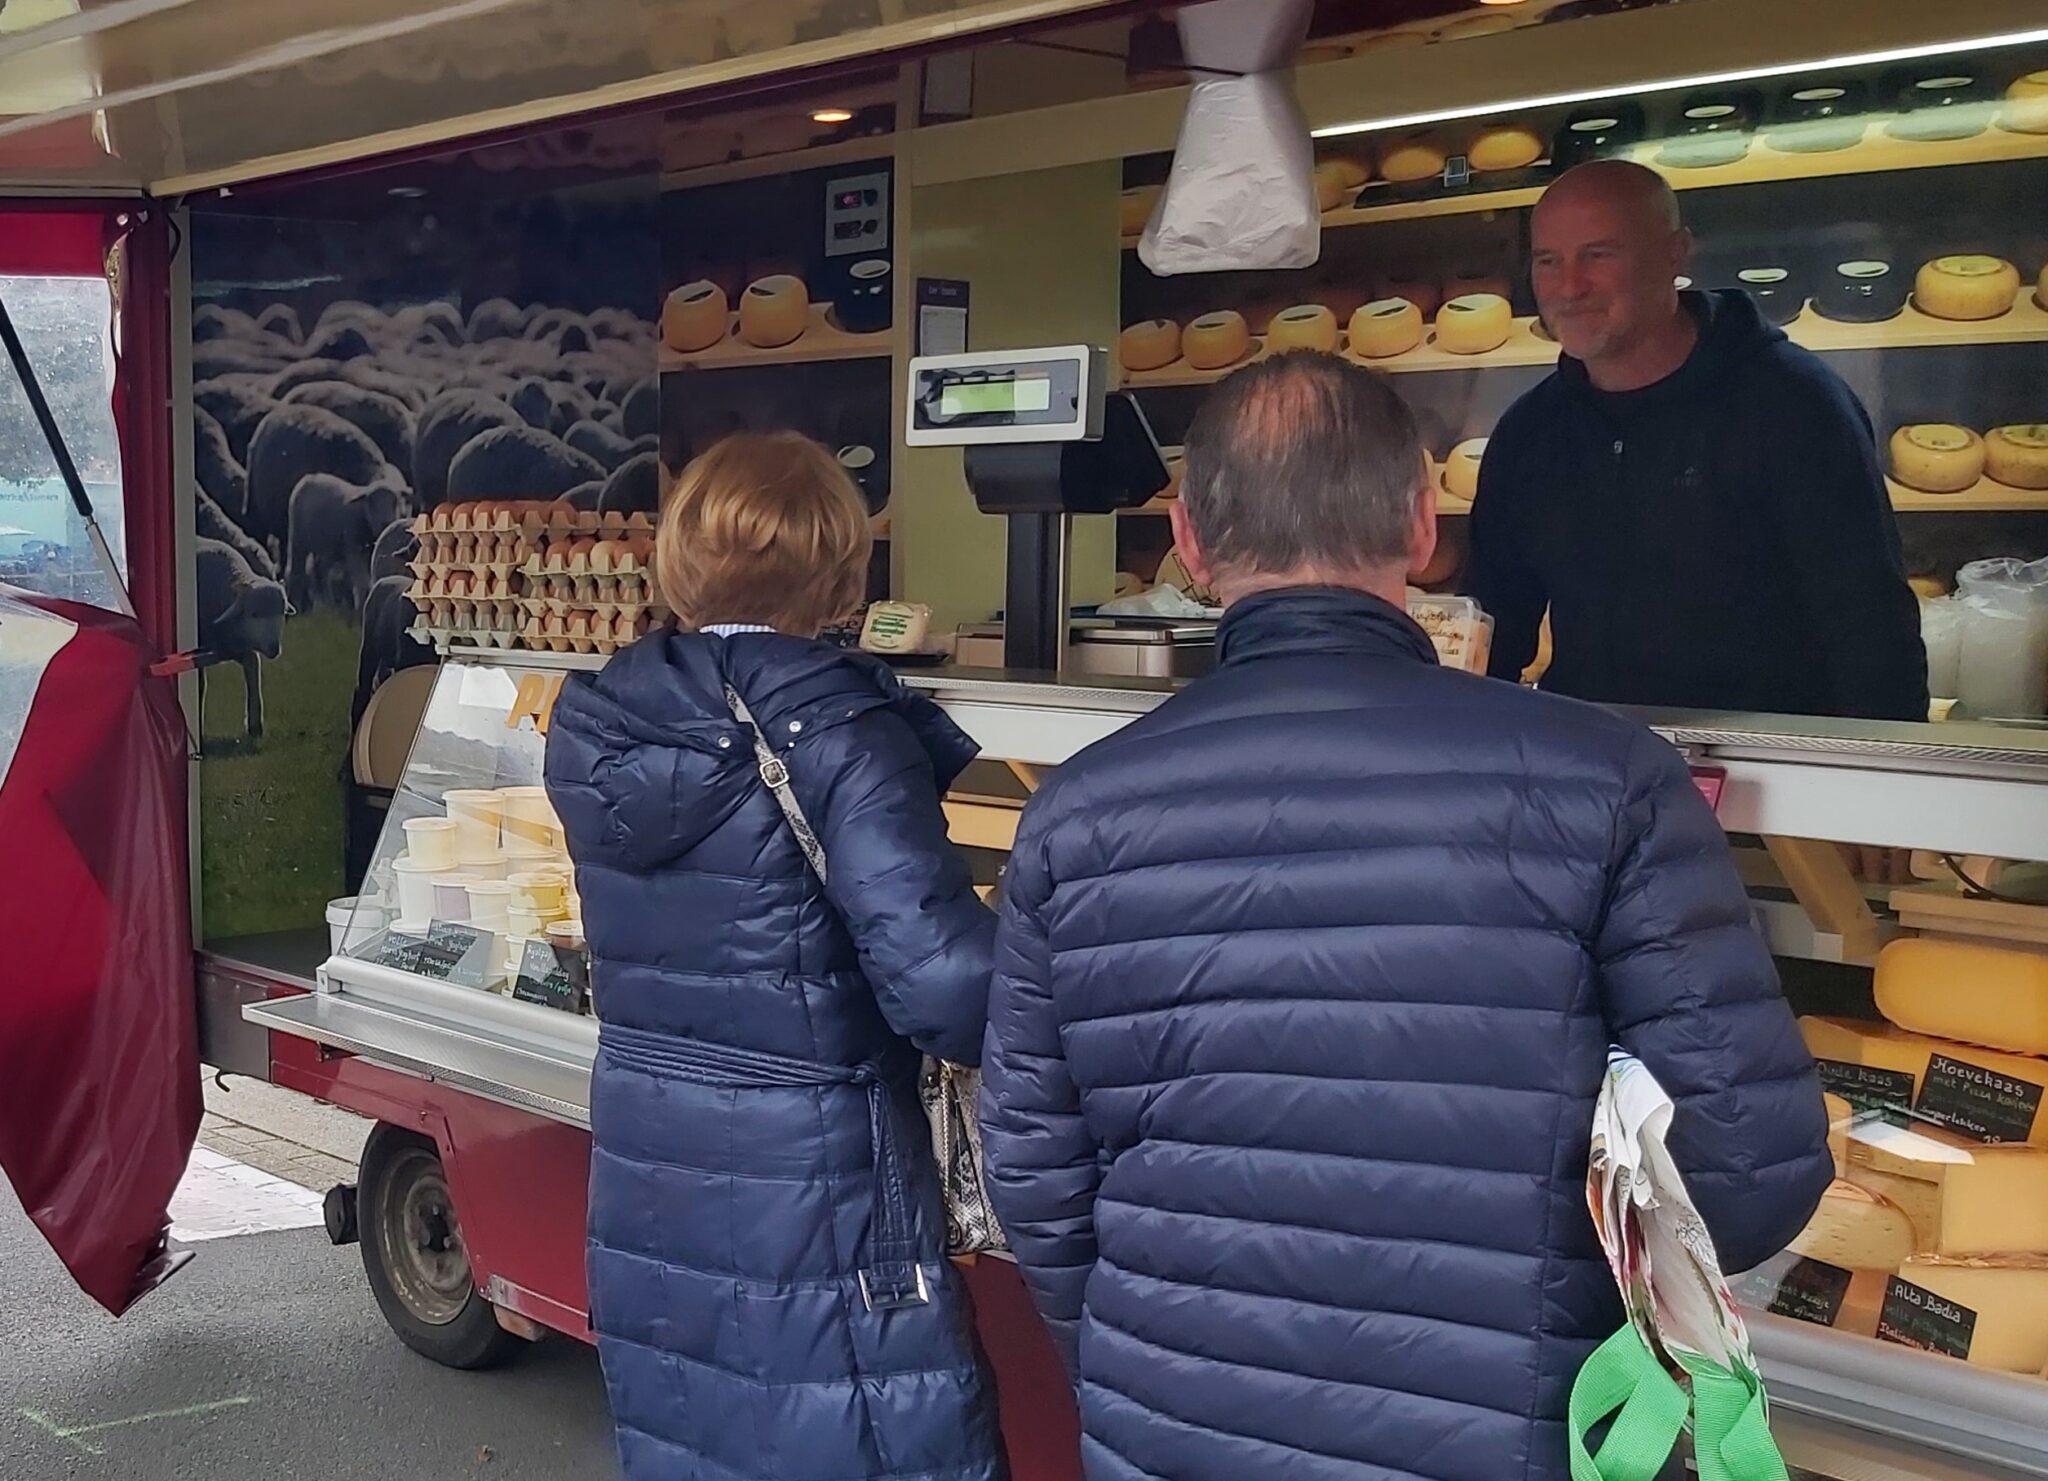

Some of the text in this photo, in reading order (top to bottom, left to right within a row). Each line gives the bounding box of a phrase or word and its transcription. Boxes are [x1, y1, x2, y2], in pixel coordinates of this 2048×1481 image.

[1932, 1057, 2025, 1098] Hoevekaas
[1895, 1284, 1961, 1324] Alta Badia
